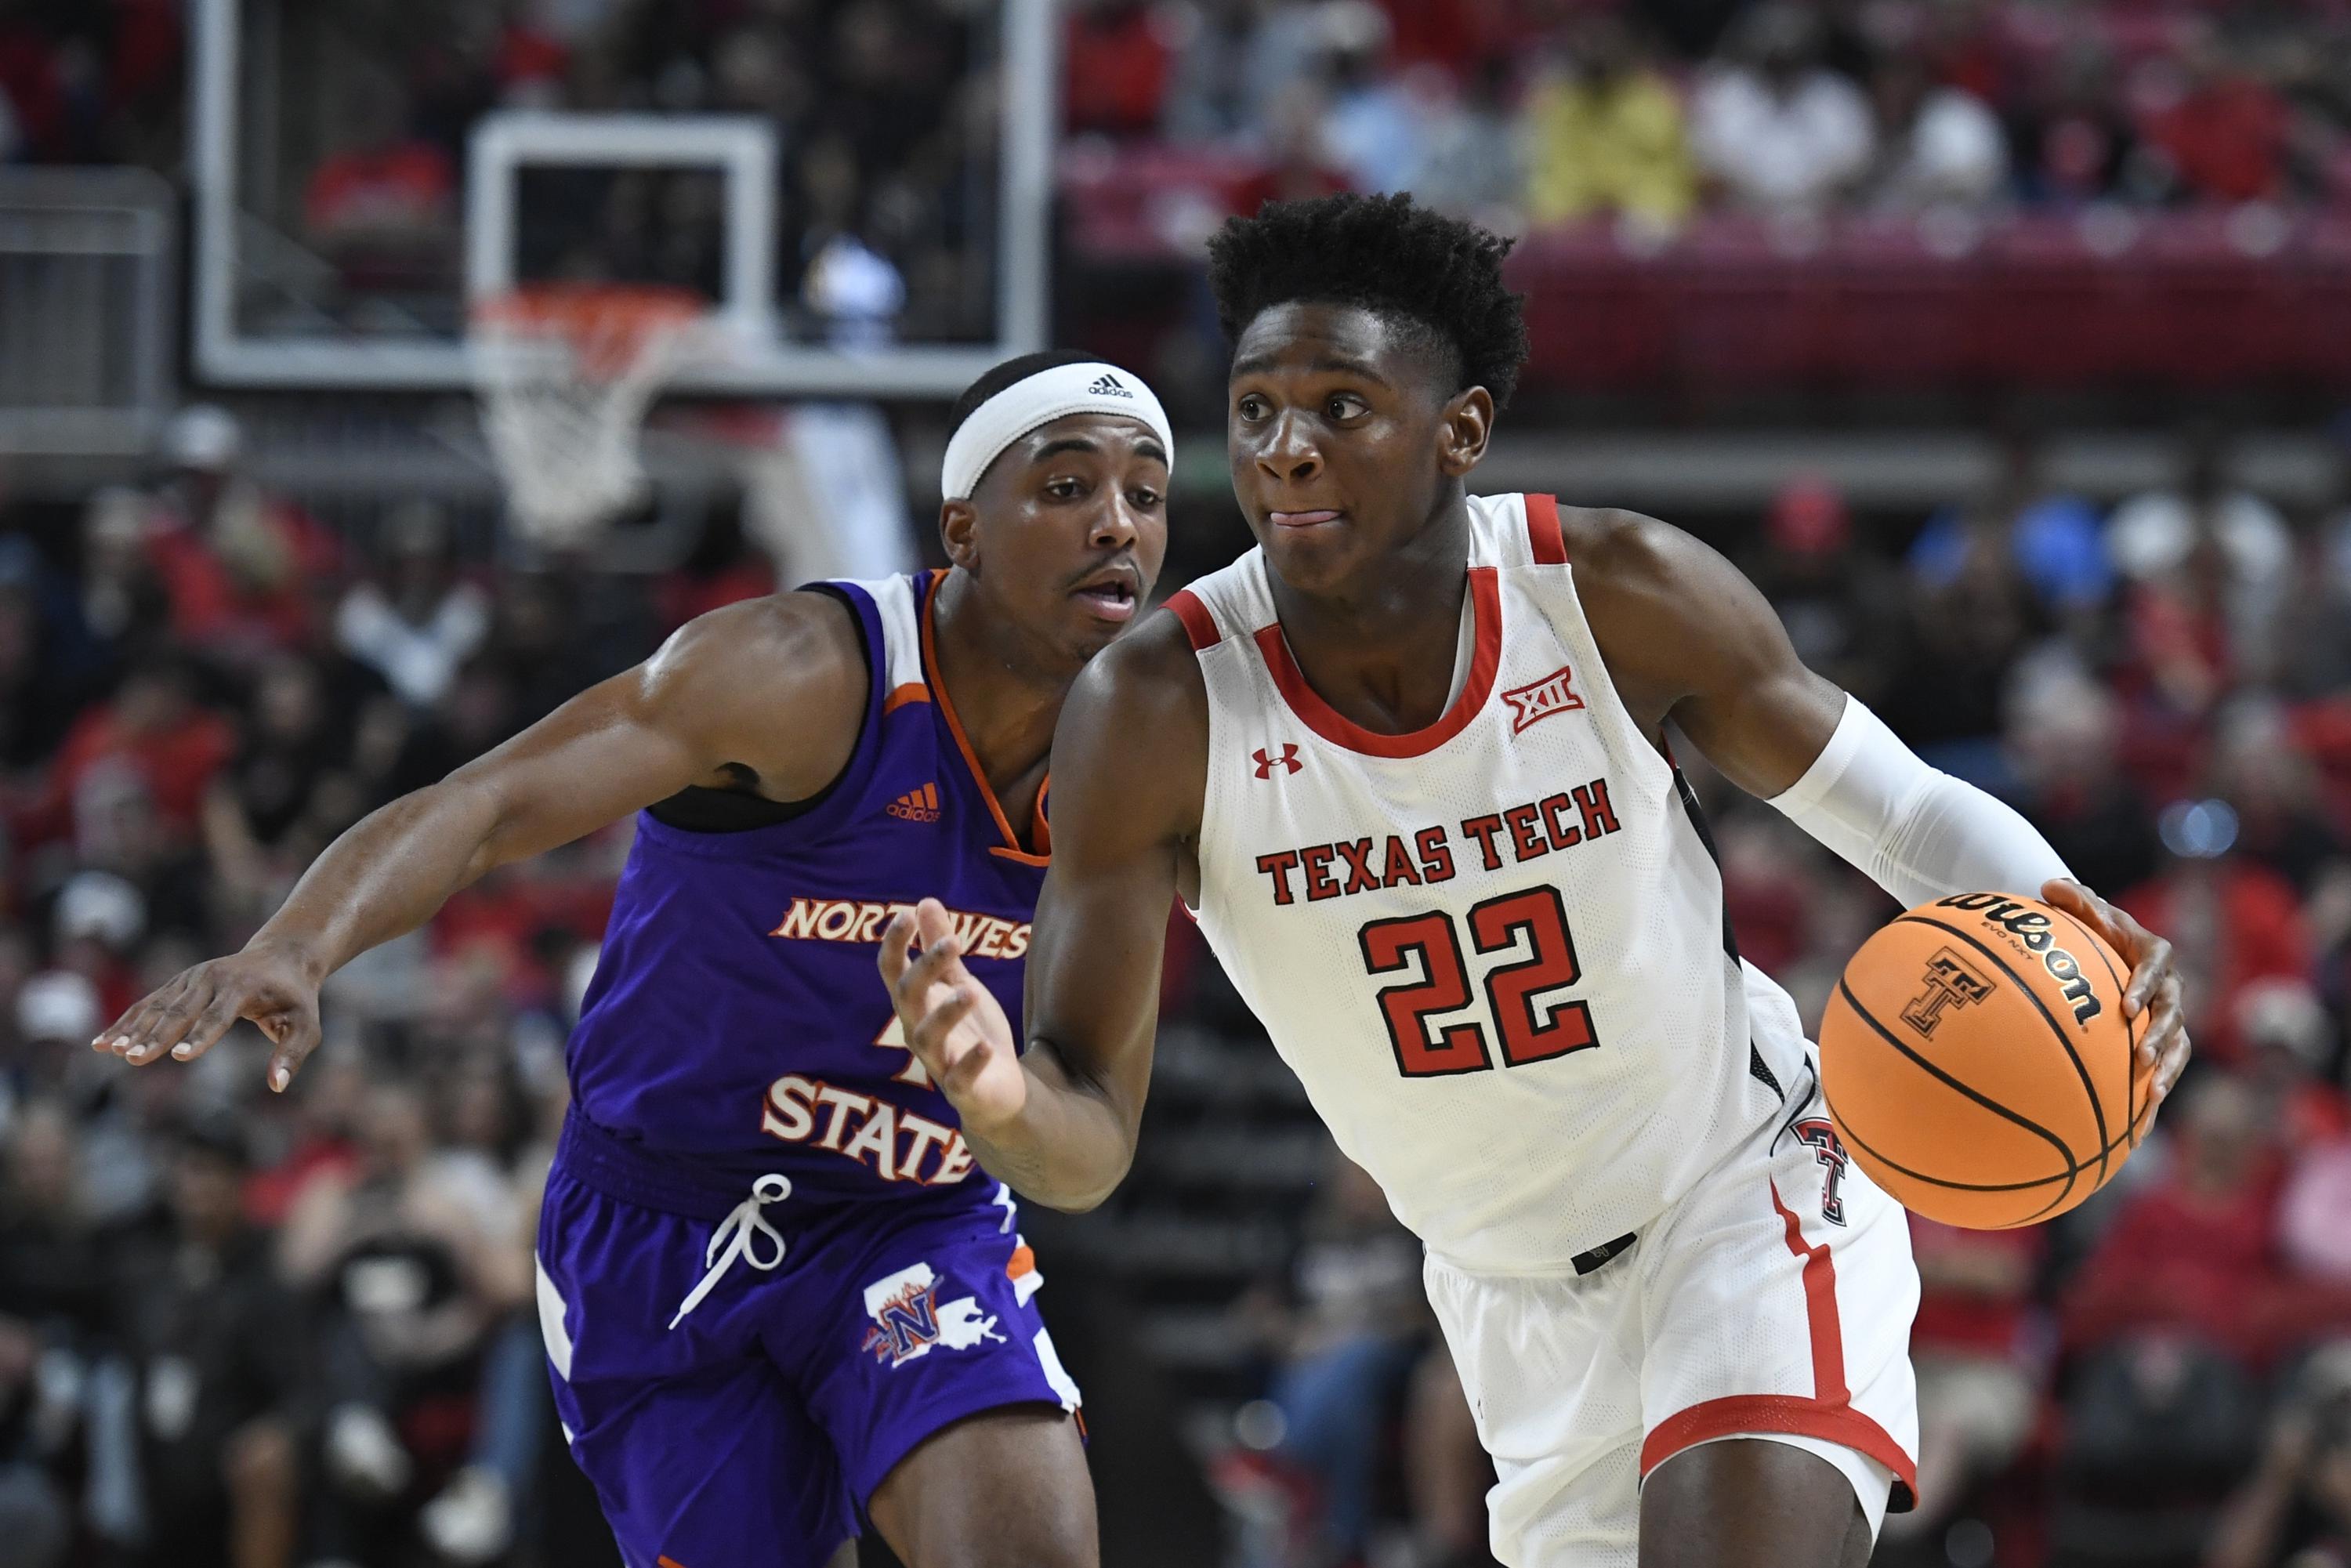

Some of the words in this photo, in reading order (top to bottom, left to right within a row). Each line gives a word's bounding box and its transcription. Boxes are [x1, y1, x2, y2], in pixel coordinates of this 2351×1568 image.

[1089, 386, 1133, 398] adidas
[886, 804, 940, 823] adidas
[1256, 825, 1455, 906] TEXAS
[1461, 778, 1621, 871] TECH
[1357, 883, 1600, 1078] 22
[1936, 893, 2102, 1026] Wilson
[1980, 921, 2007, 939] EVO
[2009, 940, 2034, 961] NXT
[761, 1074, 976, 1186] STATE
